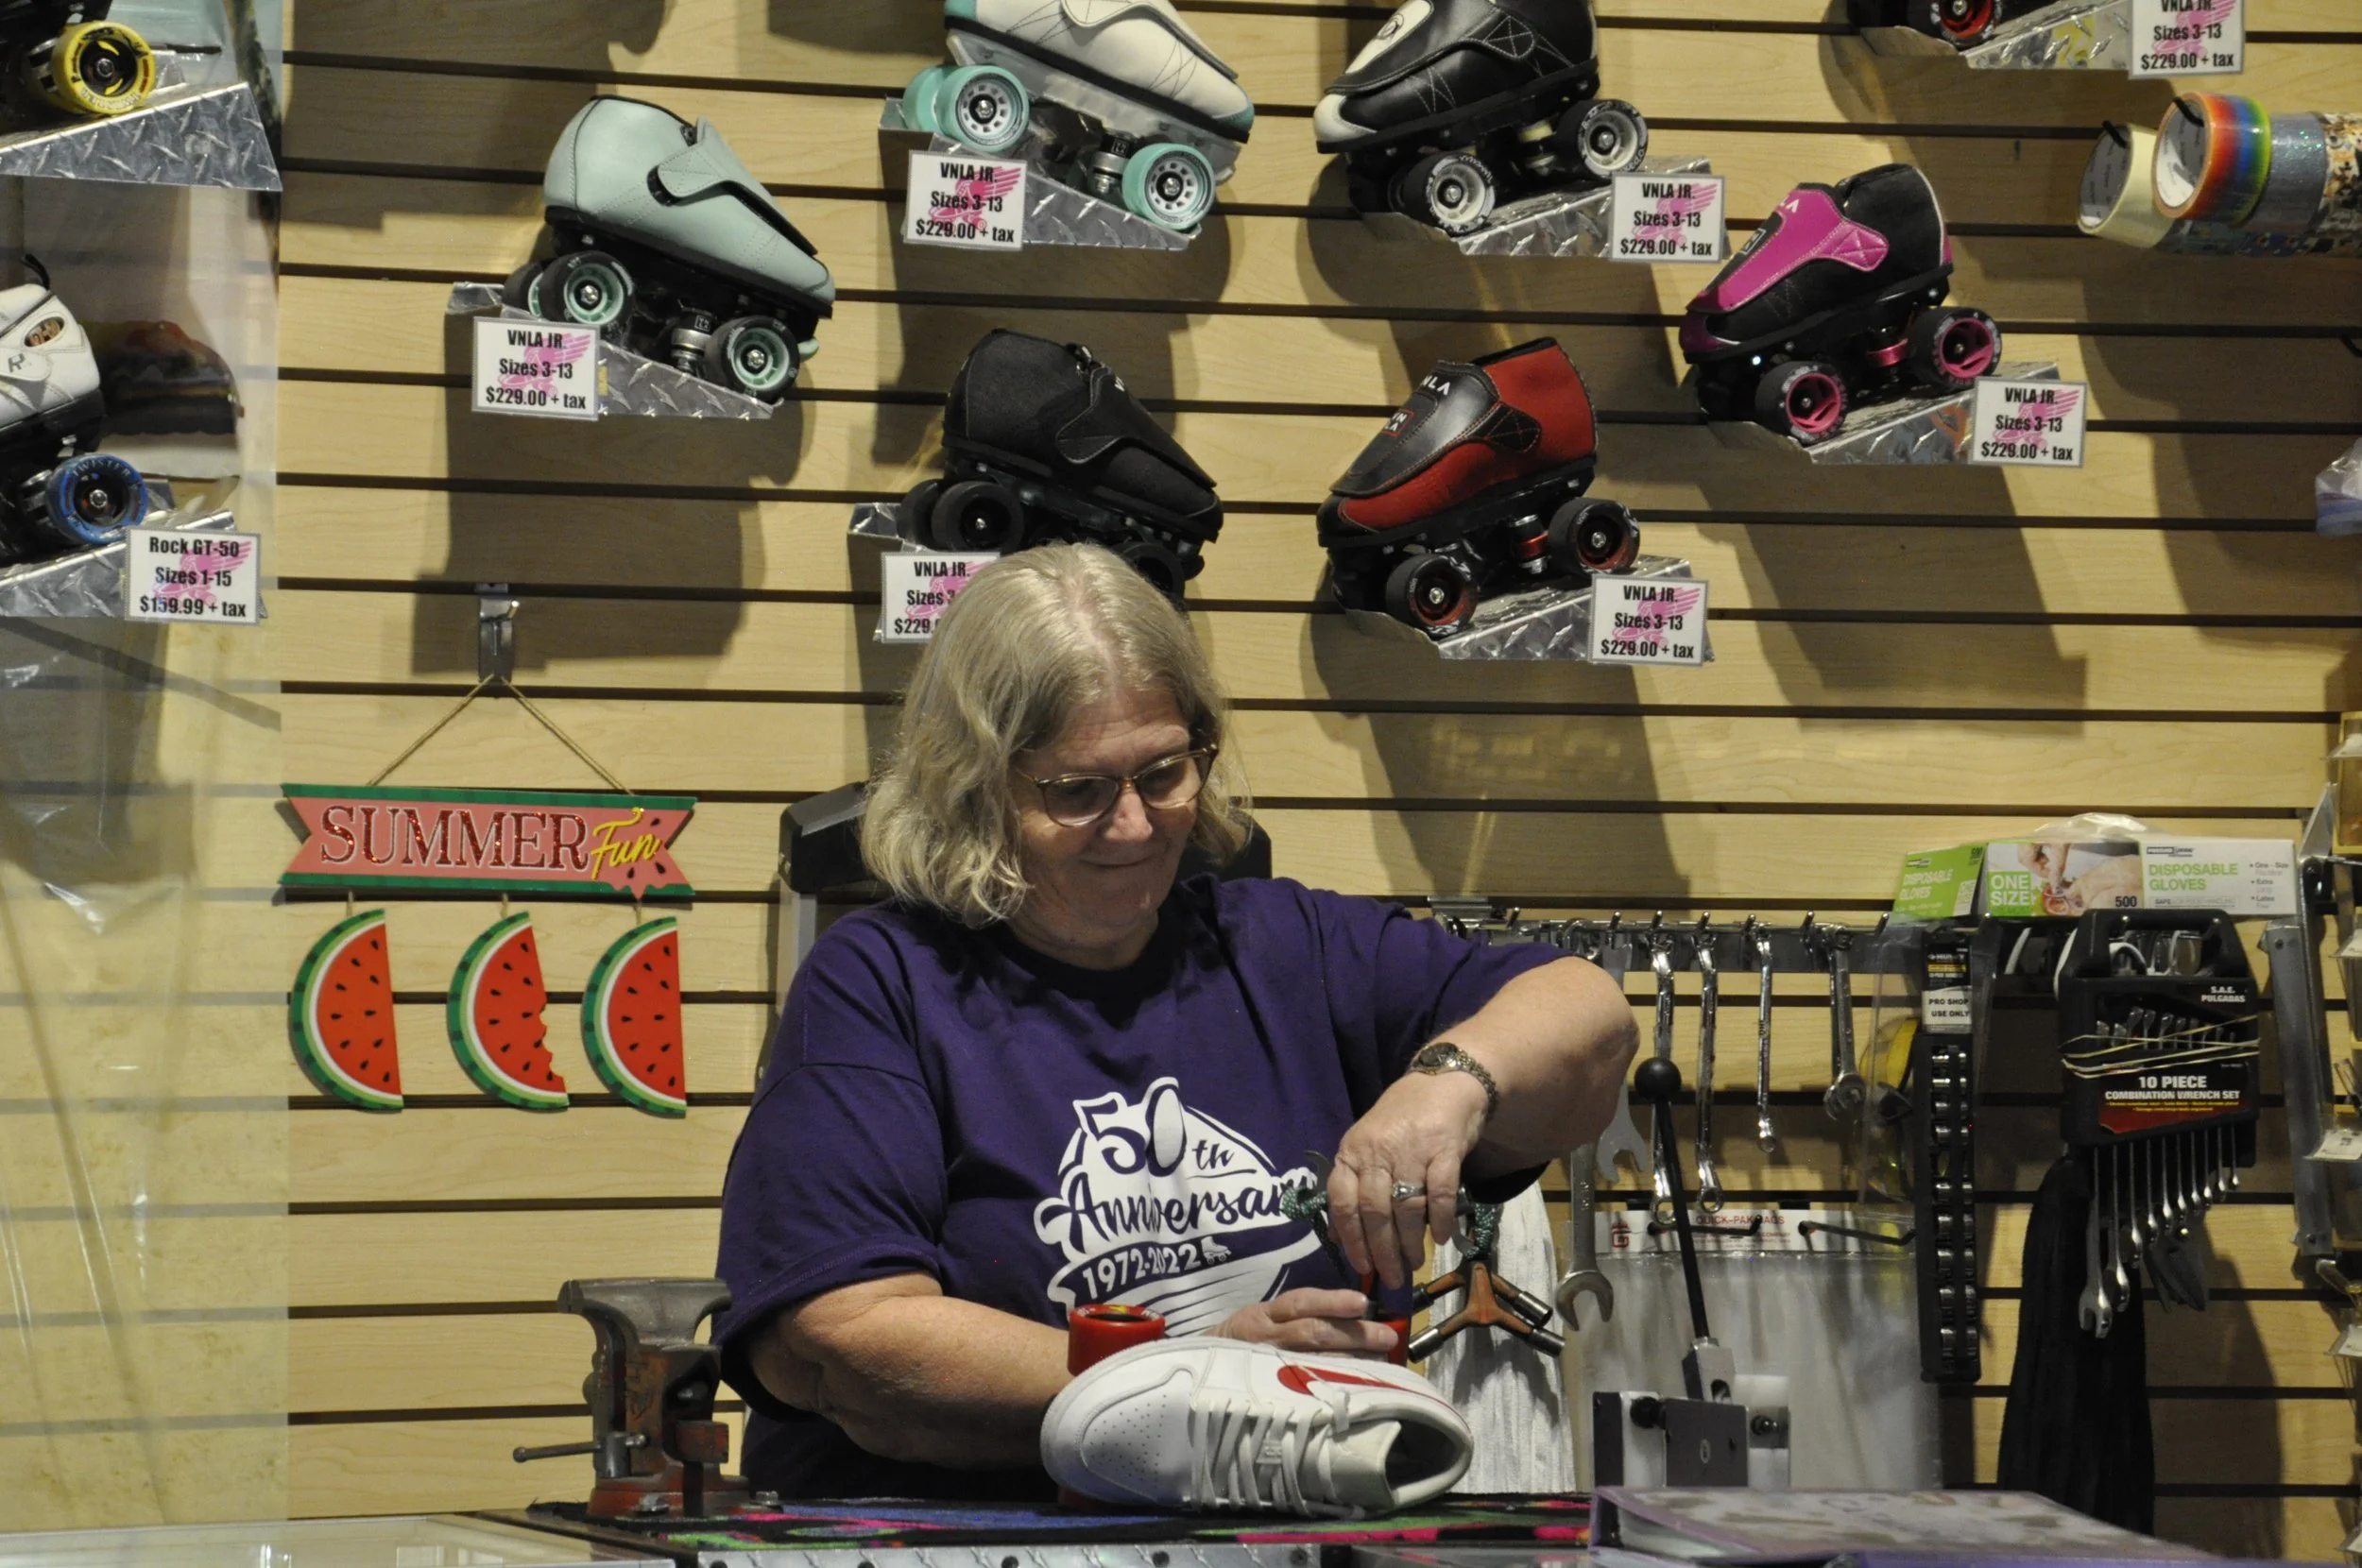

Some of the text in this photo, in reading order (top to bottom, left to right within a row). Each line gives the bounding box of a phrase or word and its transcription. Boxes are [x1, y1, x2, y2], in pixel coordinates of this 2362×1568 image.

[2153, 23, 2222, 41] Sizes 3-13
[2141, 53, 2197, 70] $229.00
[2214, 53, 2234, 67] tax
[940, 162, 998, 182] VNLA JR.
[1642, 183, 1695, 199] VNLA JR.
[931, 191, 1002, 213] Sizes 3-13
[1634, 211, 1701, 228] Sizes 3-13
[916, 218, 976, 239] $229.00
[992, 227, 1014, 243] tax
[1620, 238, 1676, 255] $229.00
[1691, 241, 1712, 256] tax
[507, 330, 567, 349] VNLA JR.
[499, 358, 573, 379] Sizes 3-13
[486, 386, 547, 406] $229.00
[563, 394, 586, 409] tax
[2005, 387, 2058, 404] VNLA JR.
[1995, 415, 2062, 433] Sizes 3-13
[1981, 441, 2037, 459] $229.00
[2053, 446, 2073, 461] tax
[149, 537, 239, 557] Rock GT-50
[155, 567, 231, 587] Sizes 1-15
[914, 561, 970, 577] VNLA JR.
[906, 589, 944, 605] Sizes
[1623, 585, 1678, 603] VNLA JR.
[140, 595, 204, 615] $159.99
[222, 601, 247, 617] tax
[894, 617, 939, 635] $229.
[1615, 612, 1684, 630] Sizes 3-13
[1600, 639, 1657, 656] $229.00
[1673, 643, 1694, 658] tax
[320, 804, 661, 880] SUMMER Fun
[2148, 862, 2238, 877] DISPOSABLE
[1991, 875, 2028, 889] ONE
[2149, 878, 2206, 892] GLOVES
[1990, 892, 2028, 906] SIZE
[2115, 895, 2137, 908] 500
[2138, 1076, 2207, 1089] 10 PIECE
[2105, 1090, 2241, 1099] COMBINATION WRENCH SET
[1082, 1243, 1201, 1300] 1972-2022
